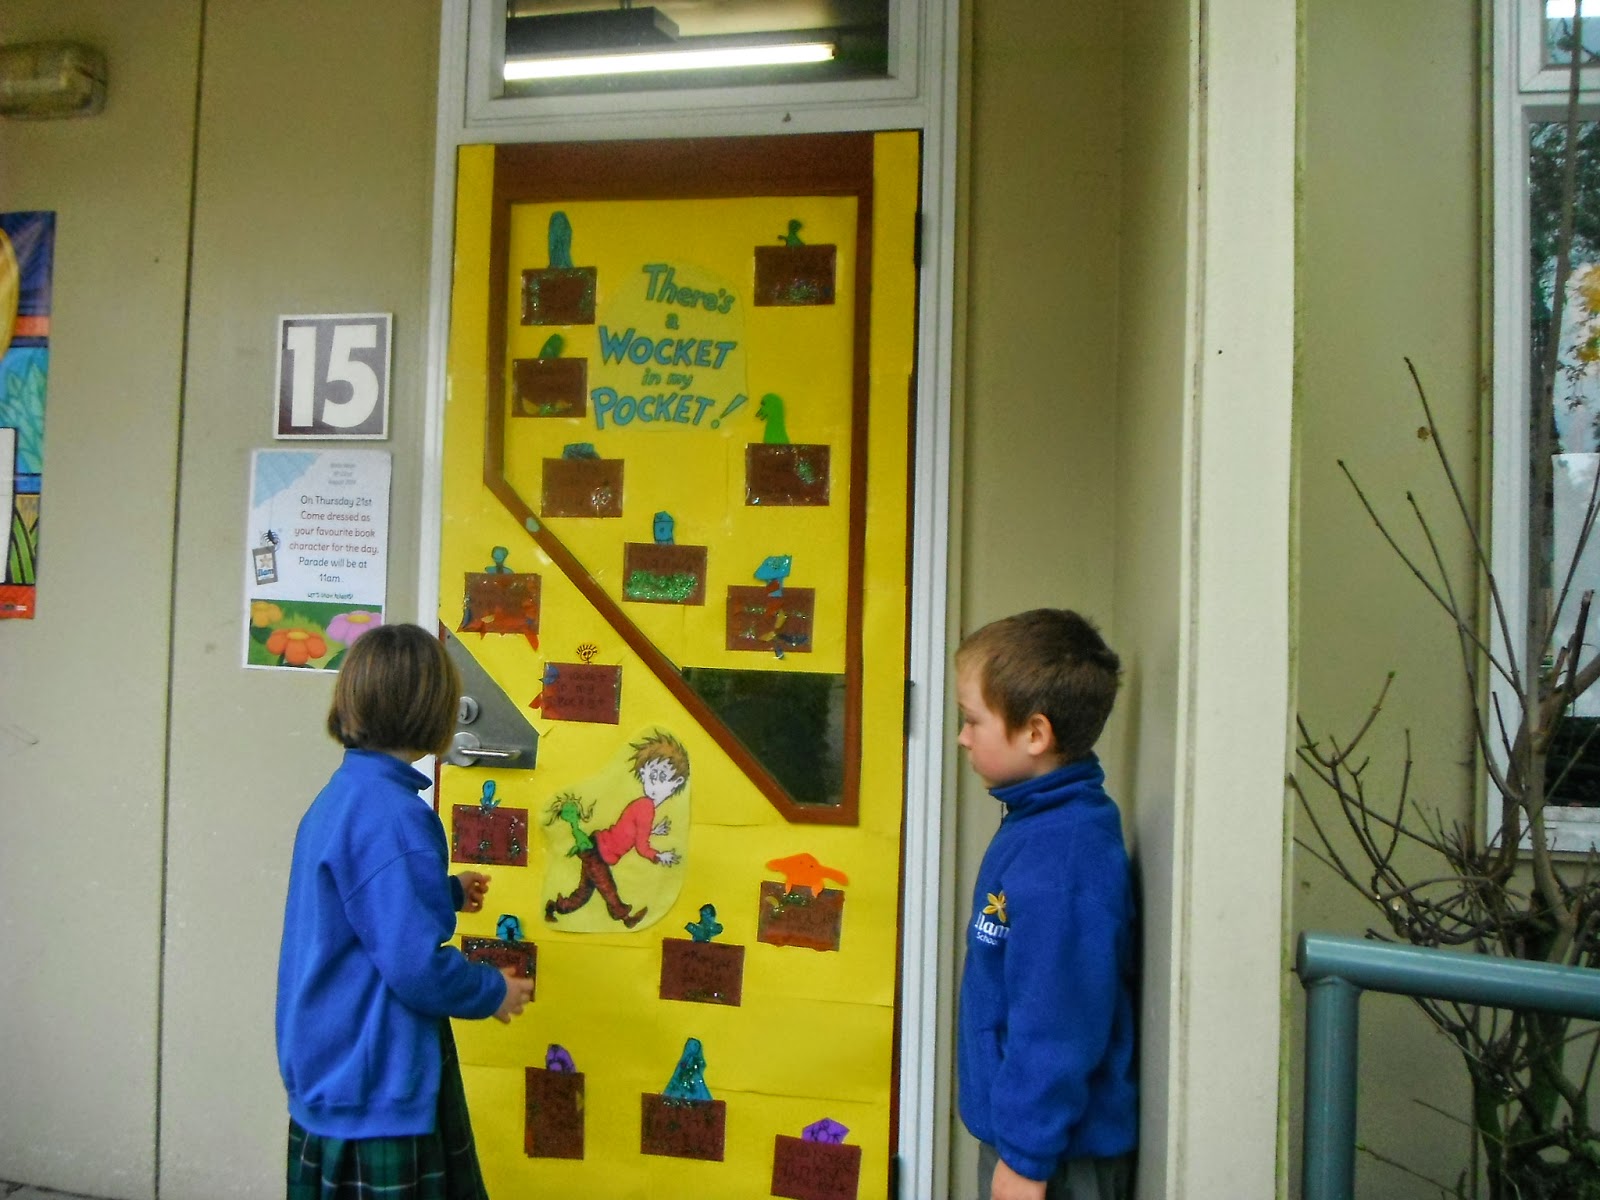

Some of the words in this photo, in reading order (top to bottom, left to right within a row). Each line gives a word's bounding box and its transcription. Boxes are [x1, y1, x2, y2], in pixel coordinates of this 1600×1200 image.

[642, 263, 736, 314] There's
[665, 313, 680, 330] a
[598, 325, 738, 370] WOCKET
[287, 324, 379, 428] 15
[641, 367, 662, 386] in
[666, 372, 693, 390] my
[300, 495, 314, 505] On
[315, 496, 354, 508] Thursday
[355, 497, 372, 506] 21st
[301, 510, 325, 521] Come
[327, 512, 359, 522] dressed
[294, 529, 314, 537] your
[316, 526, 353, 538] favourite
[354, 529, 375, 538] book
[289, 541, 329, 551] character
[331, 543, 344, 552] for
[345, 543, 361, 553] the
[299, 556, 329, 567] Parade
[330, 557, 345, 567] will
[346, 557, 357, 568] be
[358, 560, 367, 568] at
